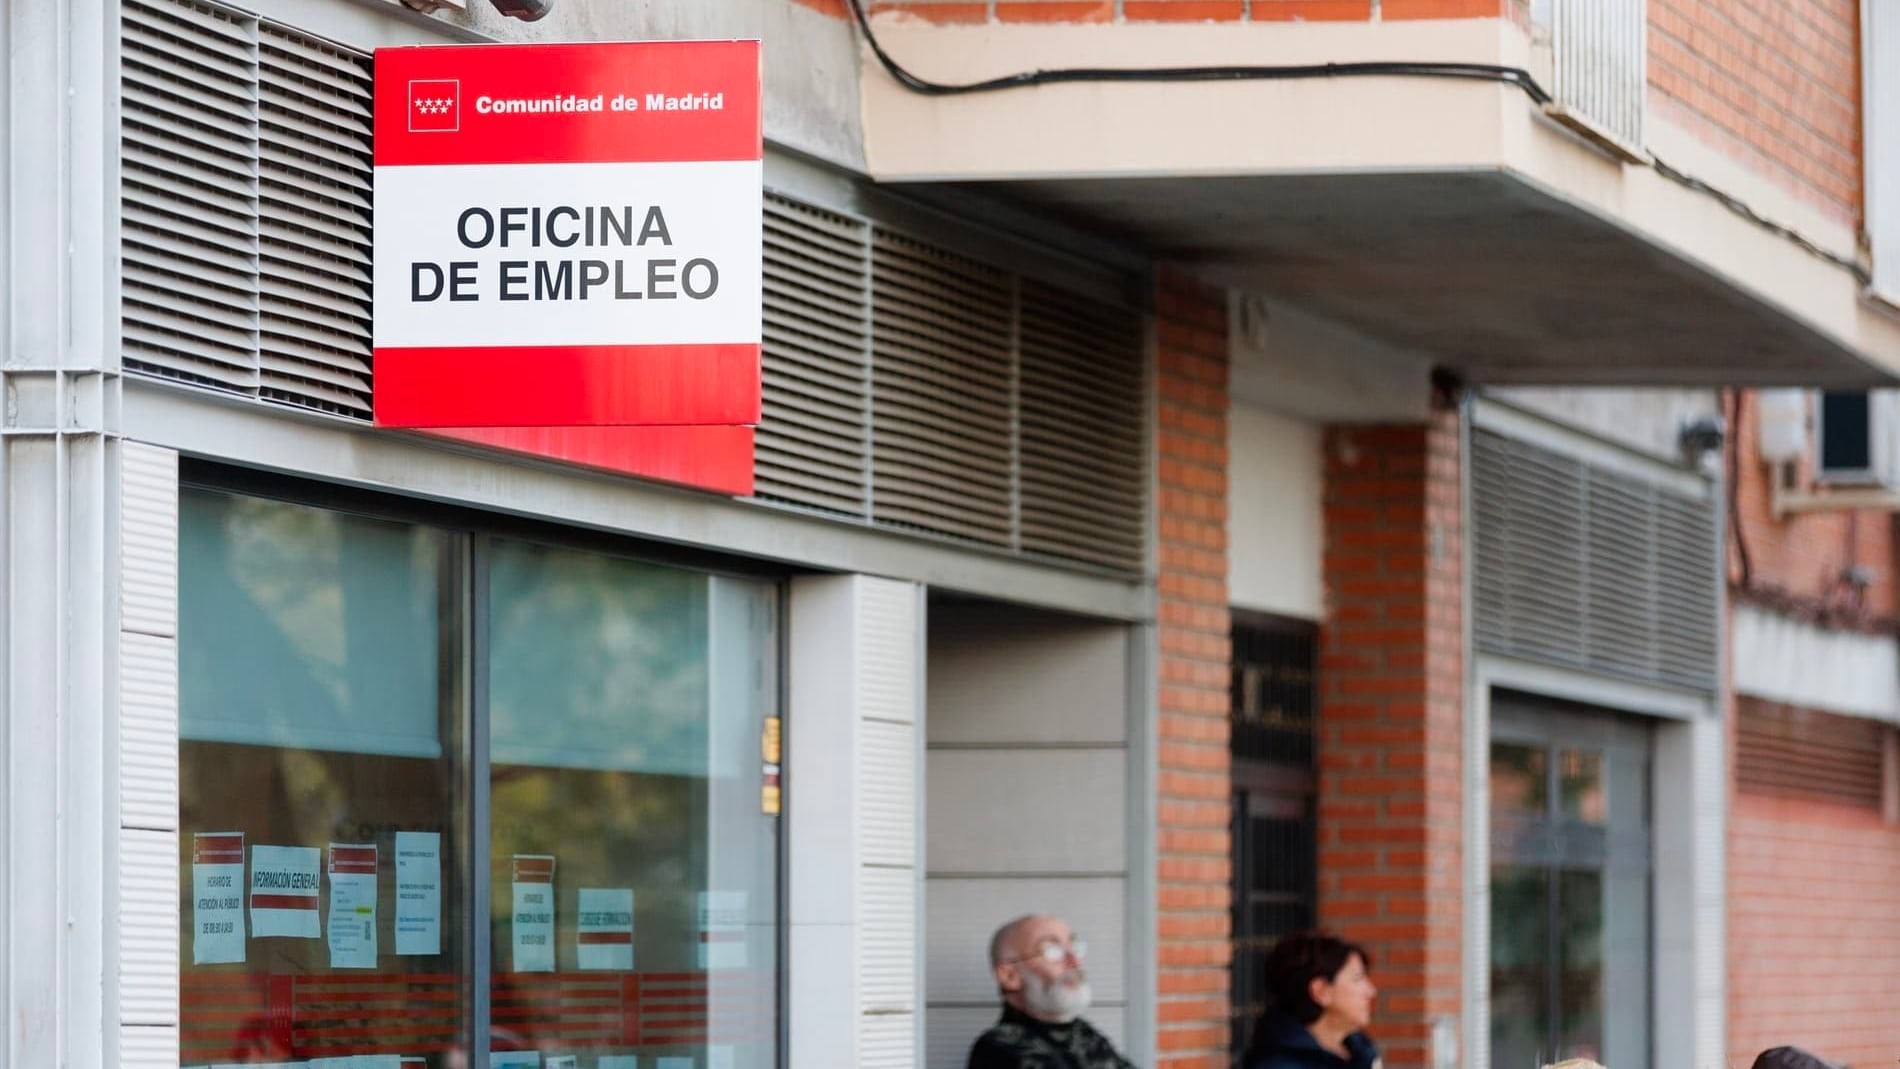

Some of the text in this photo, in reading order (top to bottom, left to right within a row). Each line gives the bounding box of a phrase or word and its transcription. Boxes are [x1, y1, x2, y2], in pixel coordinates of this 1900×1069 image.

[475, 92, 724, 114] Comunidad de Madrid
[456, 205, 673, 249] OFICINA
[411, 257, 719, 302] DE EMPLEO
[292, 872, 319, 889] GENERAL
